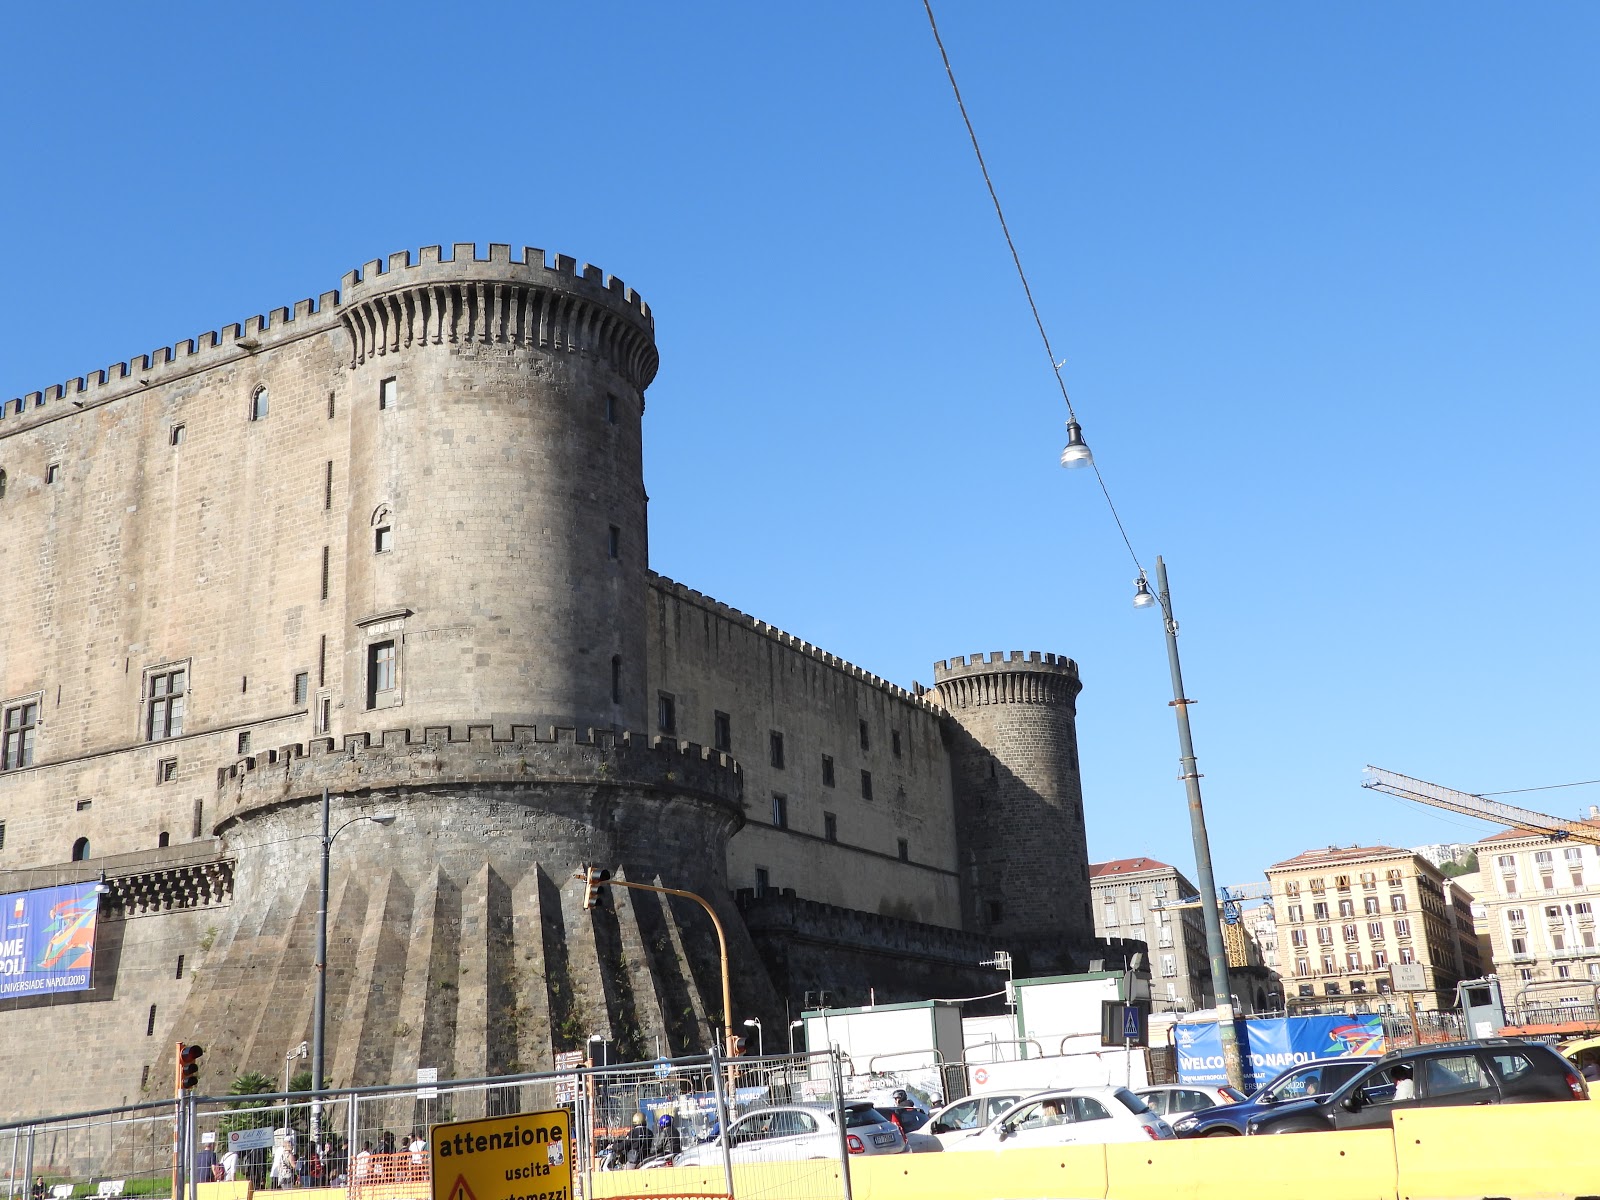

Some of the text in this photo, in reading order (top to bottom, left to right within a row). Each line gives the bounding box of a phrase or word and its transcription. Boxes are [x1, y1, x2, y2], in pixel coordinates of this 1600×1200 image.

[0, 979, 45, 993] UNIVERSIADE
[1245, 1053, 1264, 1067] TO
[1265, 1051, 1316, 1067] NAPOLI
[440, 1125, 562, 1157] attenzione
[505, 1163, 550, 1181] uscita
